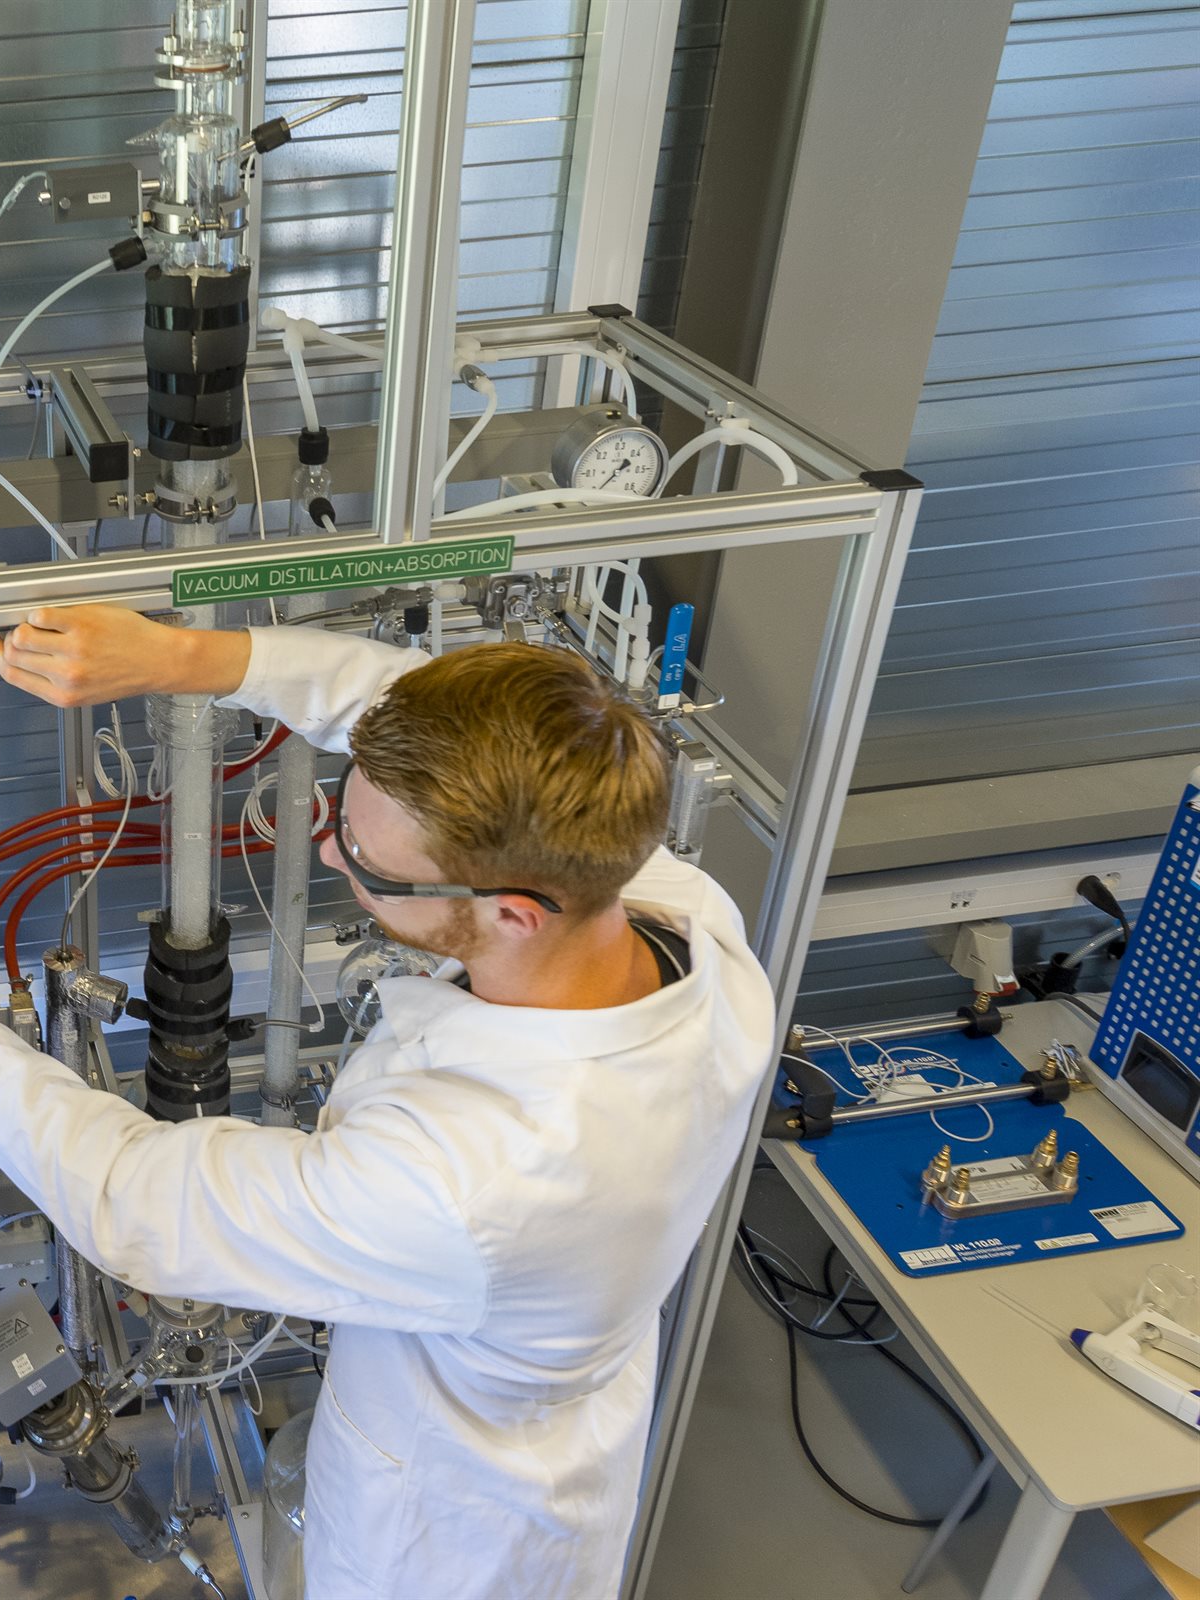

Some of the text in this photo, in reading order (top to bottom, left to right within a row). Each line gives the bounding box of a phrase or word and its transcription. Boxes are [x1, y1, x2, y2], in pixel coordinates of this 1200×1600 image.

[615, 442, 626, 451] 0.3
[596, 451, 608, 460] 0.2
[630, 449, 641, 458] 0.4
[634, 464, 647, 474] 0.5
[182, 547, 507, 595] VACUUM DISTILLATION+ABSORPTION
